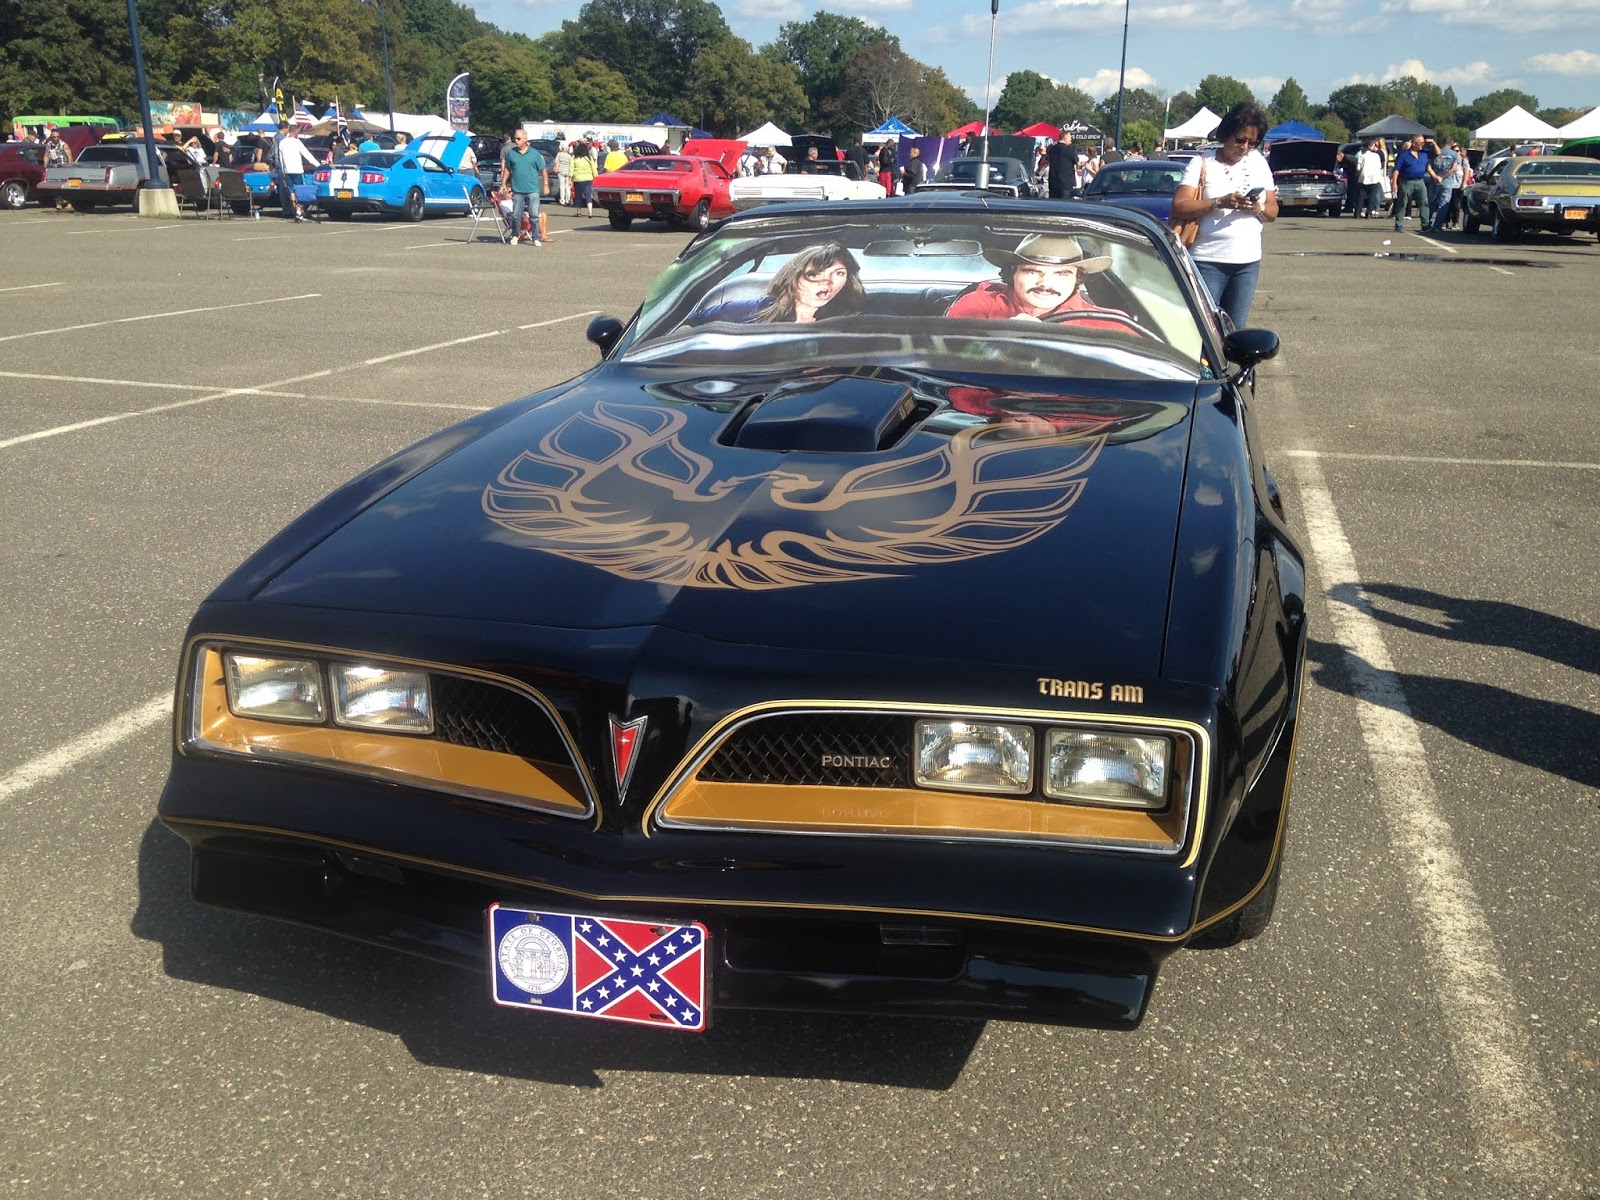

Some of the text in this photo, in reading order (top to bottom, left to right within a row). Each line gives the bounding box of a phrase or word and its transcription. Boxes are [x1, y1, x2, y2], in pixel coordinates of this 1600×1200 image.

[1037, 677, 1144, 704] TRANS AM
[821, 755, 890, 768] PONTIAC
[502, 933, 518, 963] STATE
[539, 931, 564, 972] GEORGIA
